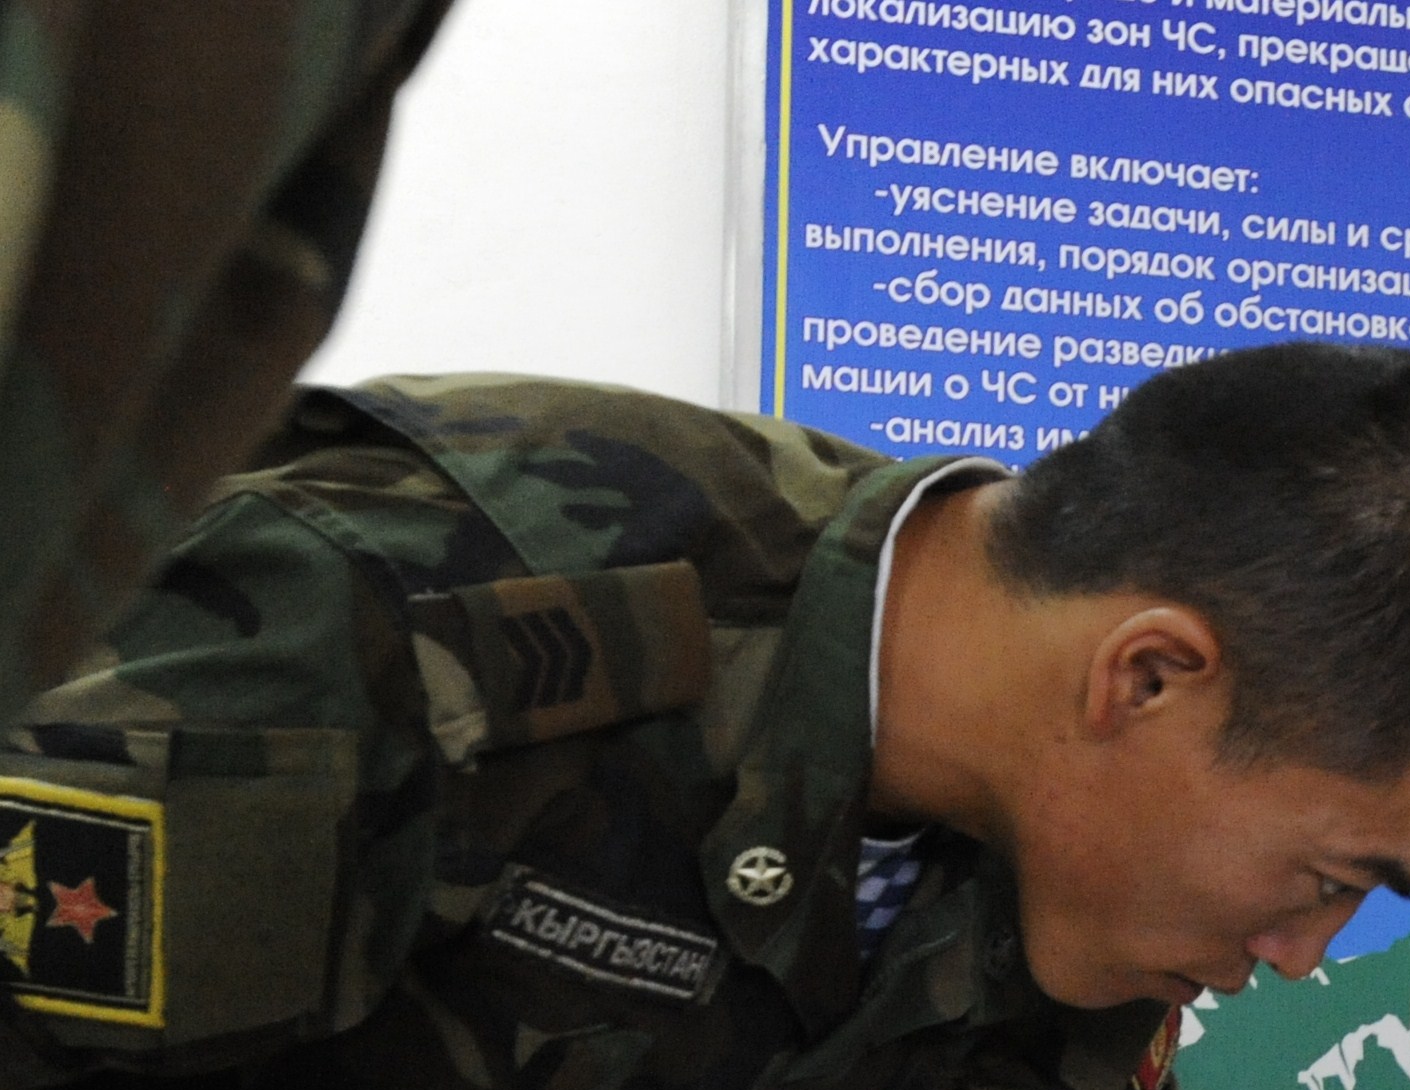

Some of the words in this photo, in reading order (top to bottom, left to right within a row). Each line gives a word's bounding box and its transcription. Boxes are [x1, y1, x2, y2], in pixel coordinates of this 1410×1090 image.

[807, 0, 1076, 41] локализацию
[1086, 18, 1151, 48] зон
[1162, 19, 1226, 60] ЧС,
[807, 37, 1070, 86] характерных
[1079, 64, 1141, 93] для
[1152, 70, 1219, 100] них
[1230, 78, 1393, 117] опасных
[817, 123, 1059, 176] Управление
[1070, 154, 1259, 194] включает:
[874, 183, 1077, 223] -уяснение
[1088, 201, 1230, 241] задачи,
[1241, 214, 1336, 245] силы
[1347, 223, 1369, 248] и
[805, 223, 1046, 272] выполнения,
[1059, 244, 1215, 281] порядок
[873, 268, 992, 315] -сбор
[1000, 286, 1143, 320] данных
[1154, 290, 1205, 325] об
[803, 316, 1042, 359] проведение
[802, 363, 932, 397] мации
[944, 374, 970, 400] о
[981, 369, 1037, 405] ЧС
[1048, 381, 1089, 408] от
[870, 416, 1025, 451] -анализ
